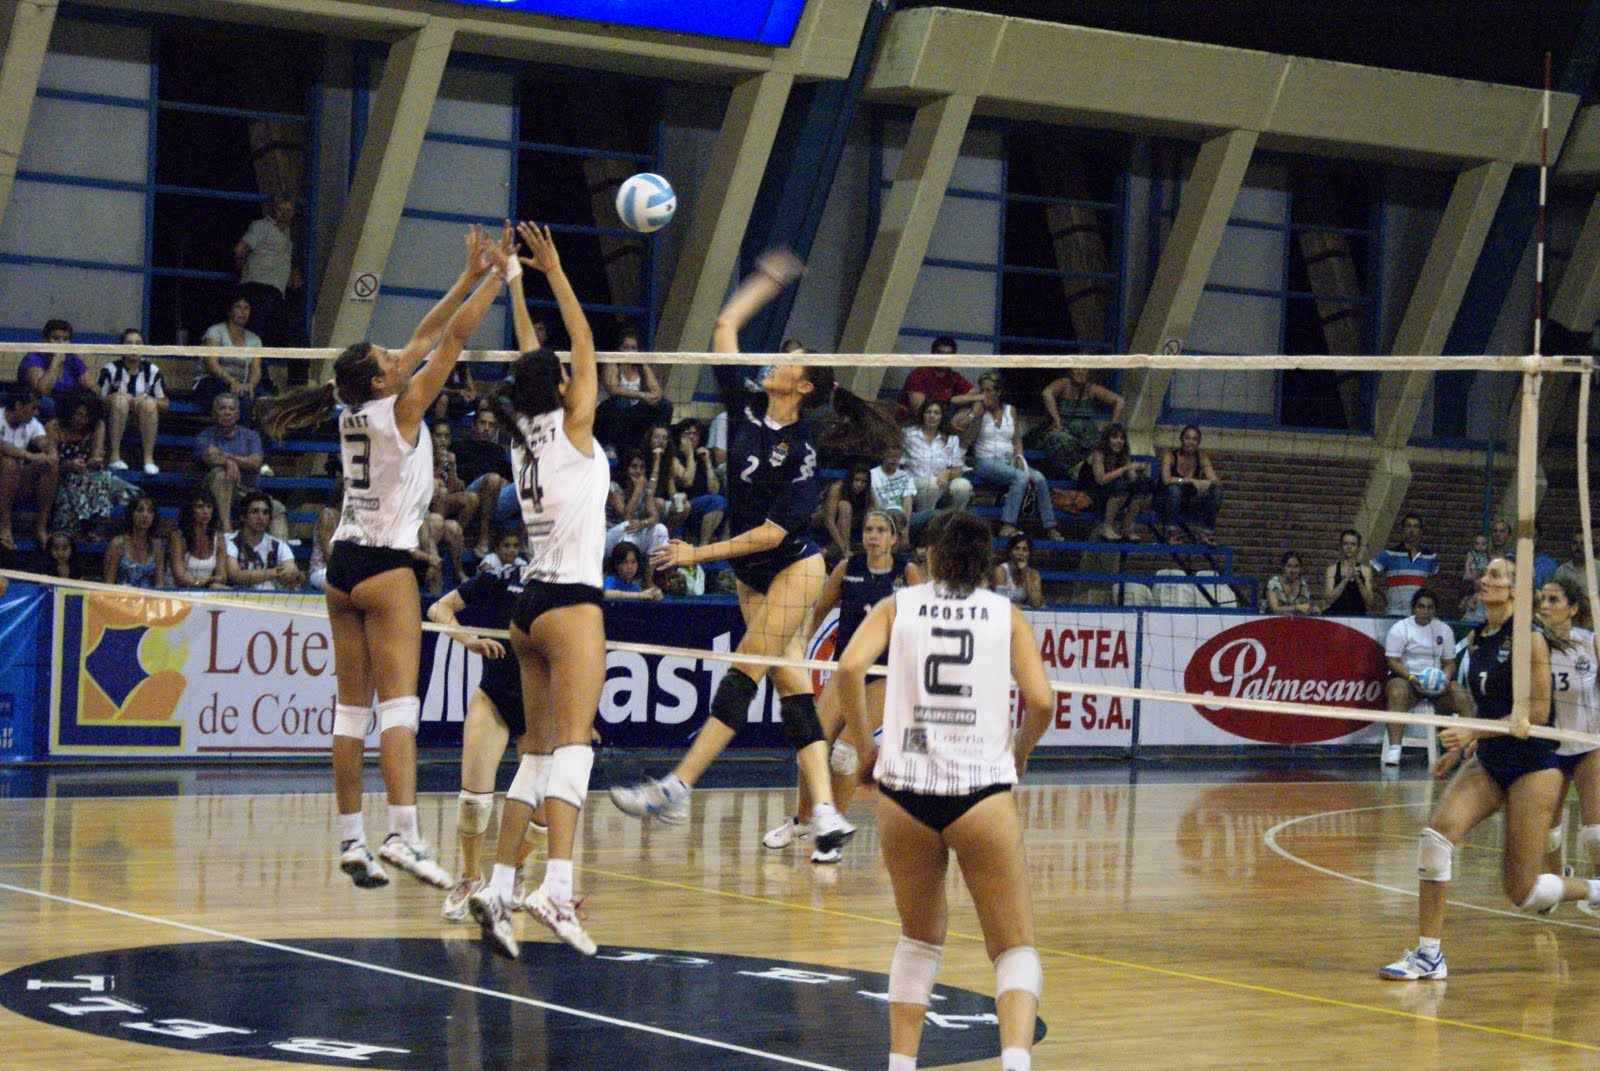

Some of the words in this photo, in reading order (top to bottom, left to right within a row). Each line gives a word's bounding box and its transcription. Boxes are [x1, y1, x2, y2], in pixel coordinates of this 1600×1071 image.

[344, 433, 371, 490] 3
[519, 457, 544, 513] 4
[740, 455, 760, 483] 2
[918, 604, 989, 621] ACOSTA
[203, 610, 338, 676] Lote
[924, 627, 974, 697] 2
[1203, 637, 1382, 711] Palmesano
[1550, 672, 1570, 691] 13
[198, 692, 239, 735] de
[252, 692, 377, 736] Córd
[1080, 694, 1131, 730] S.A.
